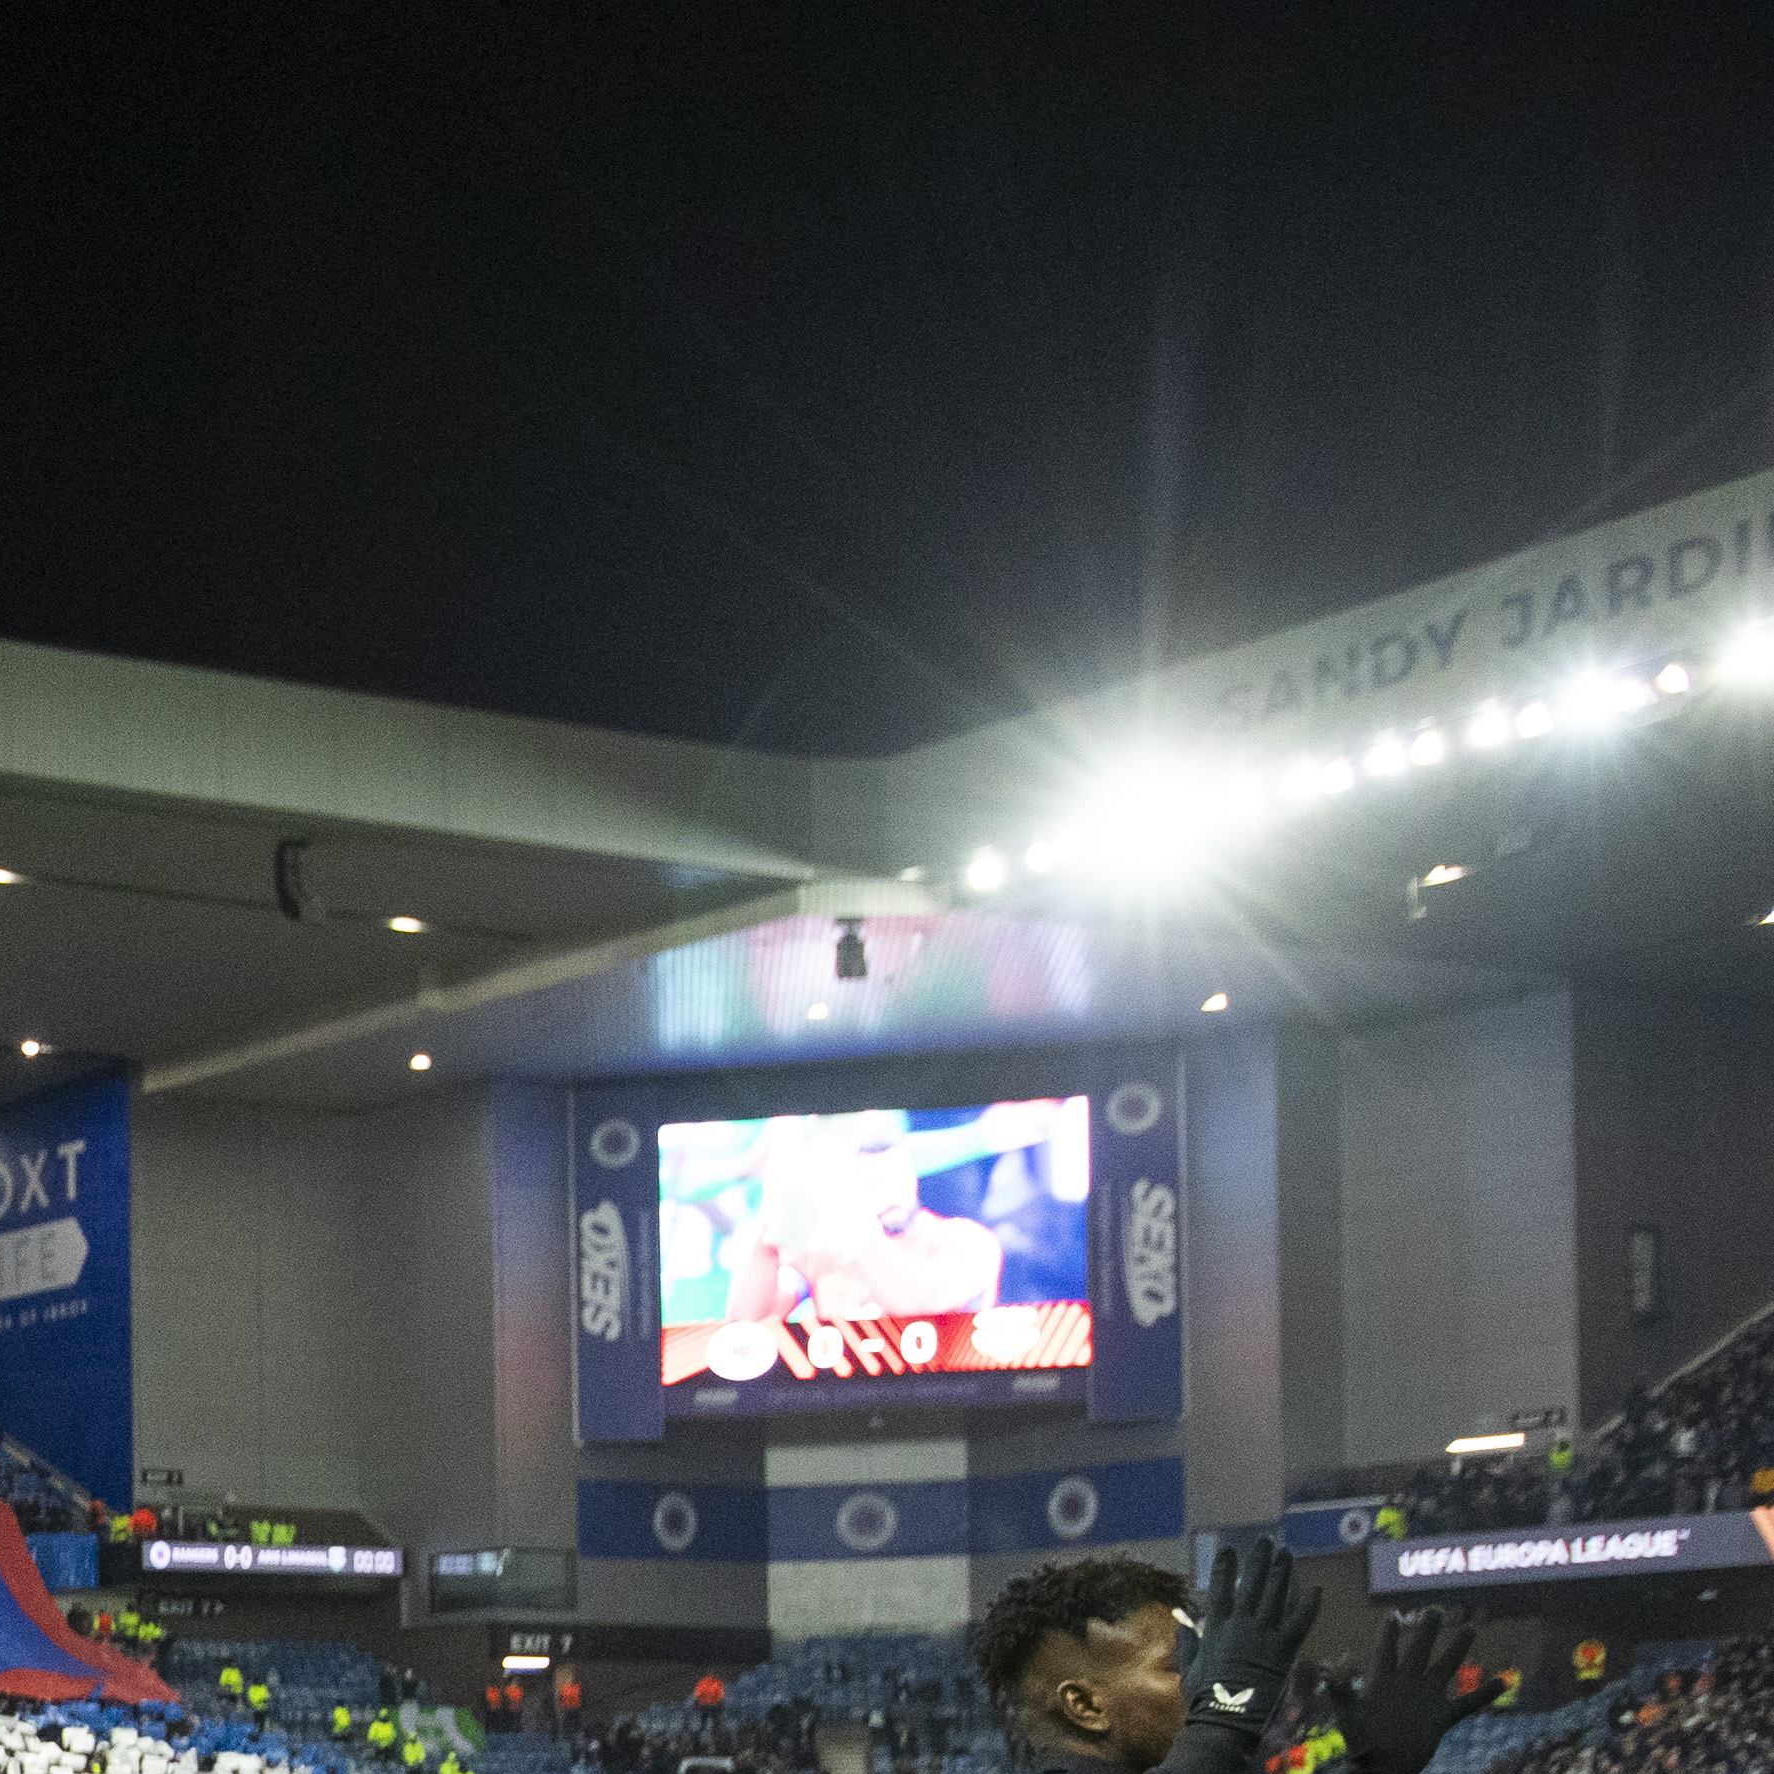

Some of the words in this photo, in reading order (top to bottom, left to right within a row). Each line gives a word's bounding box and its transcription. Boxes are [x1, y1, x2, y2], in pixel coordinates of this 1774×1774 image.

[1502, 508, 1774, 646] JARDI
[808, 1326, 844, 1368] 0
[901, 1321, 938, 1364] 0
[1398, 1547, 1467, 1577] UEFA
[1467, 1538, 1570, 1572] EUROPA
[1570, 1529, 1679, 1563] LEAGUE
[509, 1633, 551, 1652] EXIT
